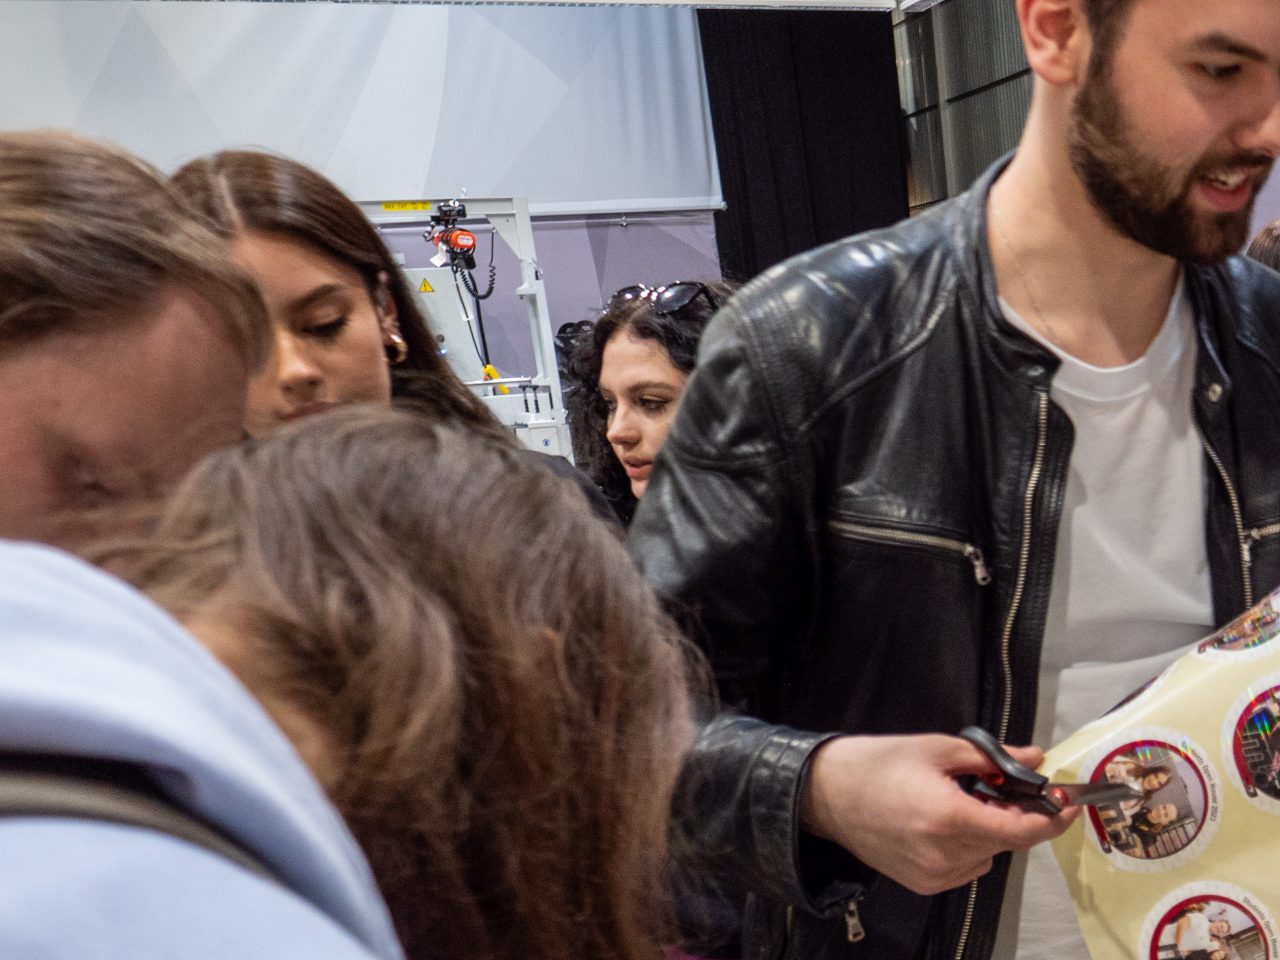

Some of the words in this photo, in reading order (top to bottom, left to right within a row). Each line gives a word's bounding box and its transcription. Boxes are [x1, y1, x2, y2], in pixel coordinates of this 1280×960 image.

[1202, 765, 1214, 784] Open
[1209, 783, 1219, 804] House
[1242, 896, 1265, 920] Students
[1263, 920, 1274, 938] Open
[1271, 938, 1279, 959] House
